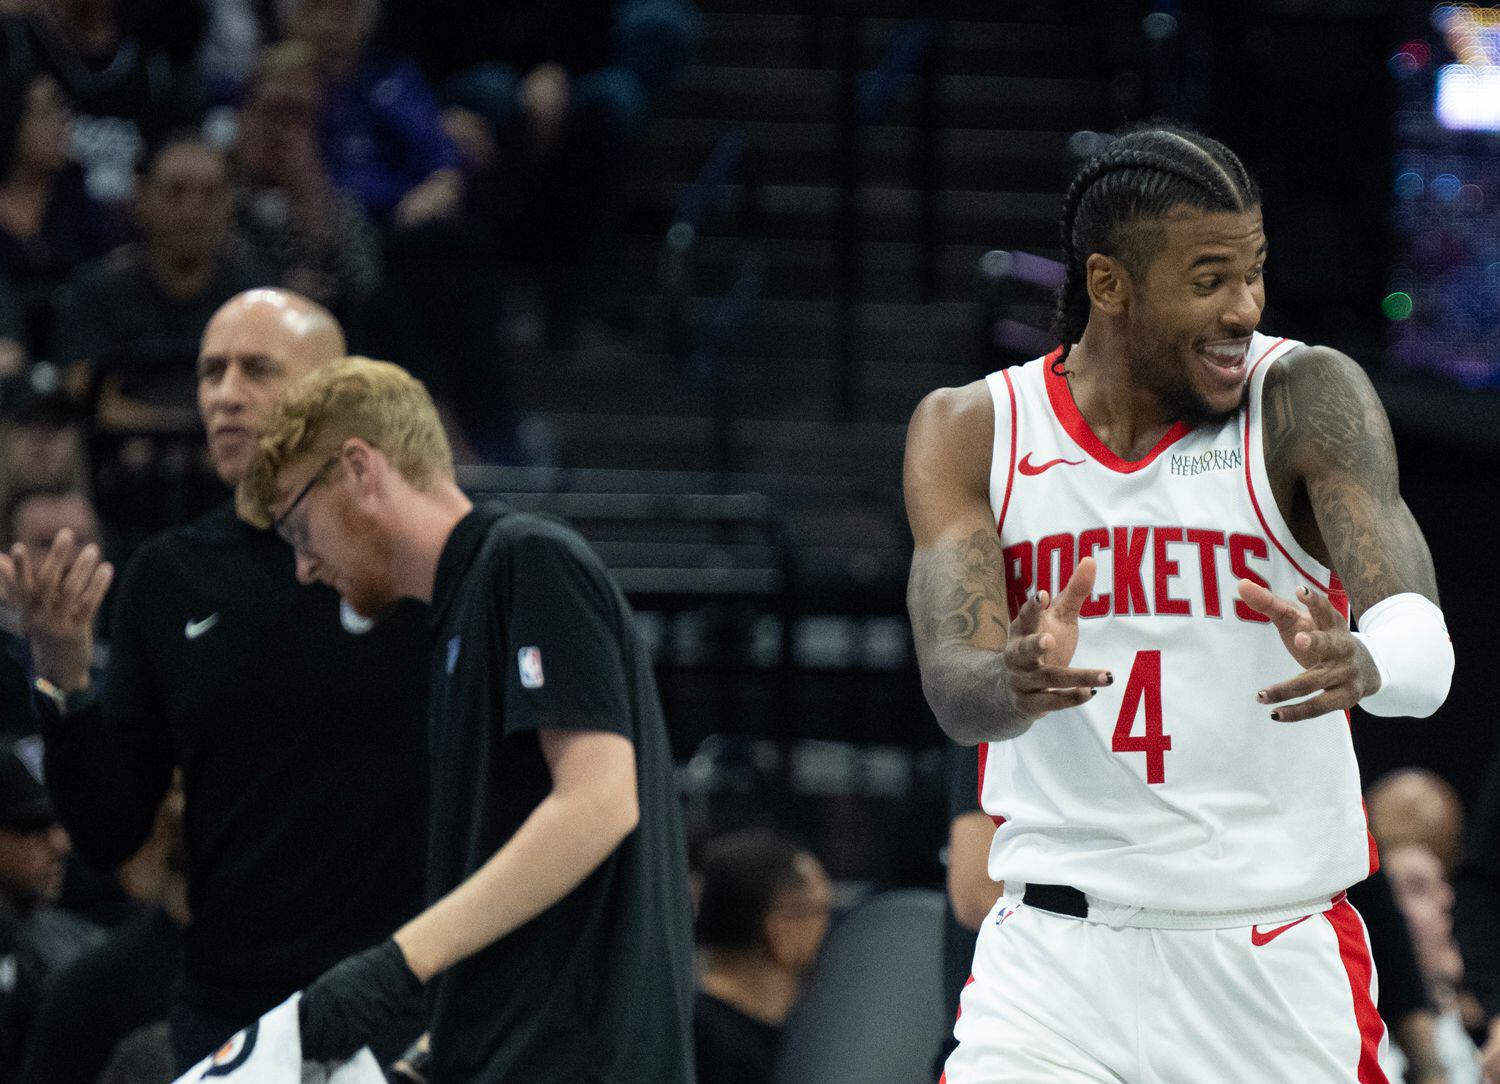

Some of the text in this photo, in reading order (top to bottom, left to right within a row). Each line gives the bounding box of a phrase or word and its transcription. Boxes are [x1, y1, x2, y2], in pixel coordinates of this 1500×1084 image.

[1171, 447, 1242, 467] MEMORIAL
[1171, 457, 1242, 476] HERMANN
[1111, 649, 1172, 785] 4
